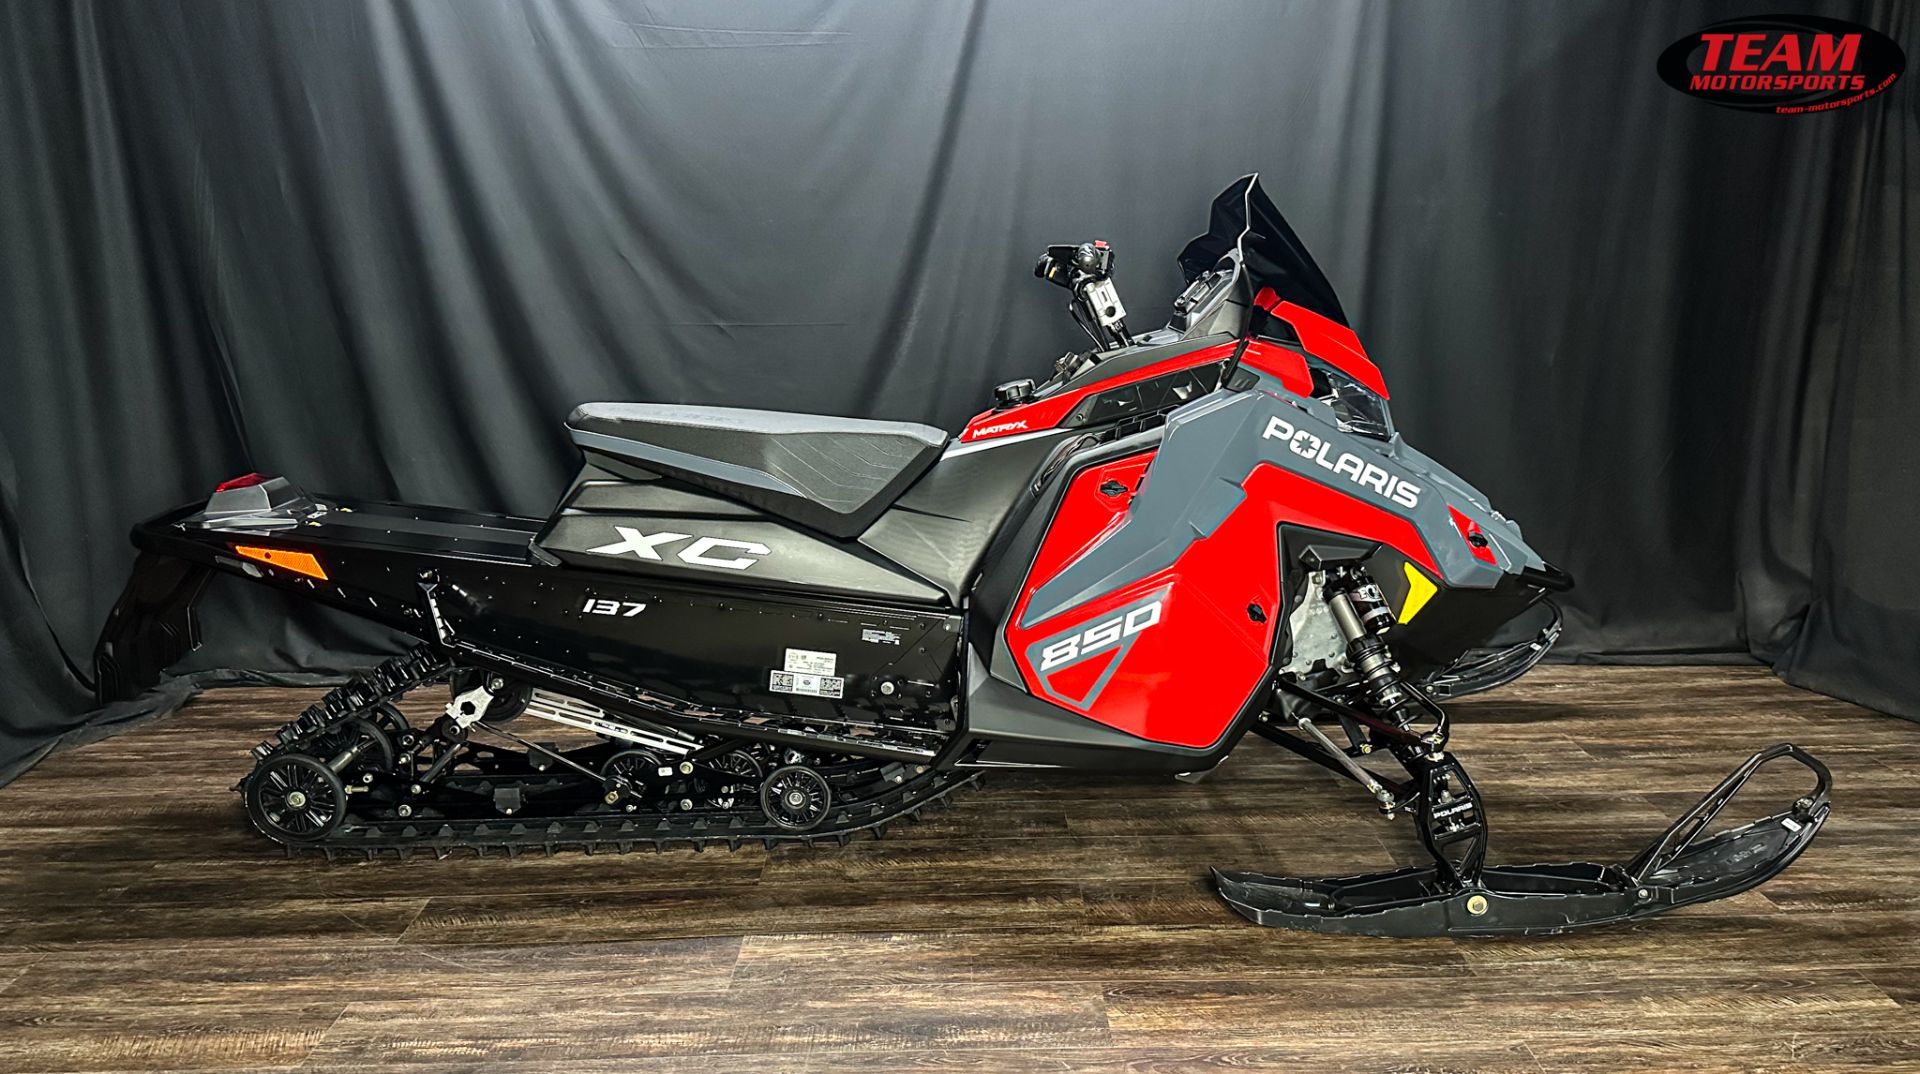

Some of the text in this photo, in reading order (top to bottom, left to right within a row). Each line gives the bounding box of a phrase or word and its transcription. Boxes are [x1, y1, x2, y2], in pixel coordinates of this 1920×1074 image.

[972, 420, 1029, 438] MATRYX
[1262, 416, 1422, 509] POLARIS
[585, 525, 772, 570] XC
[582, 598, 647, 617] 137
[1040, 600, 1162, 672] 850
